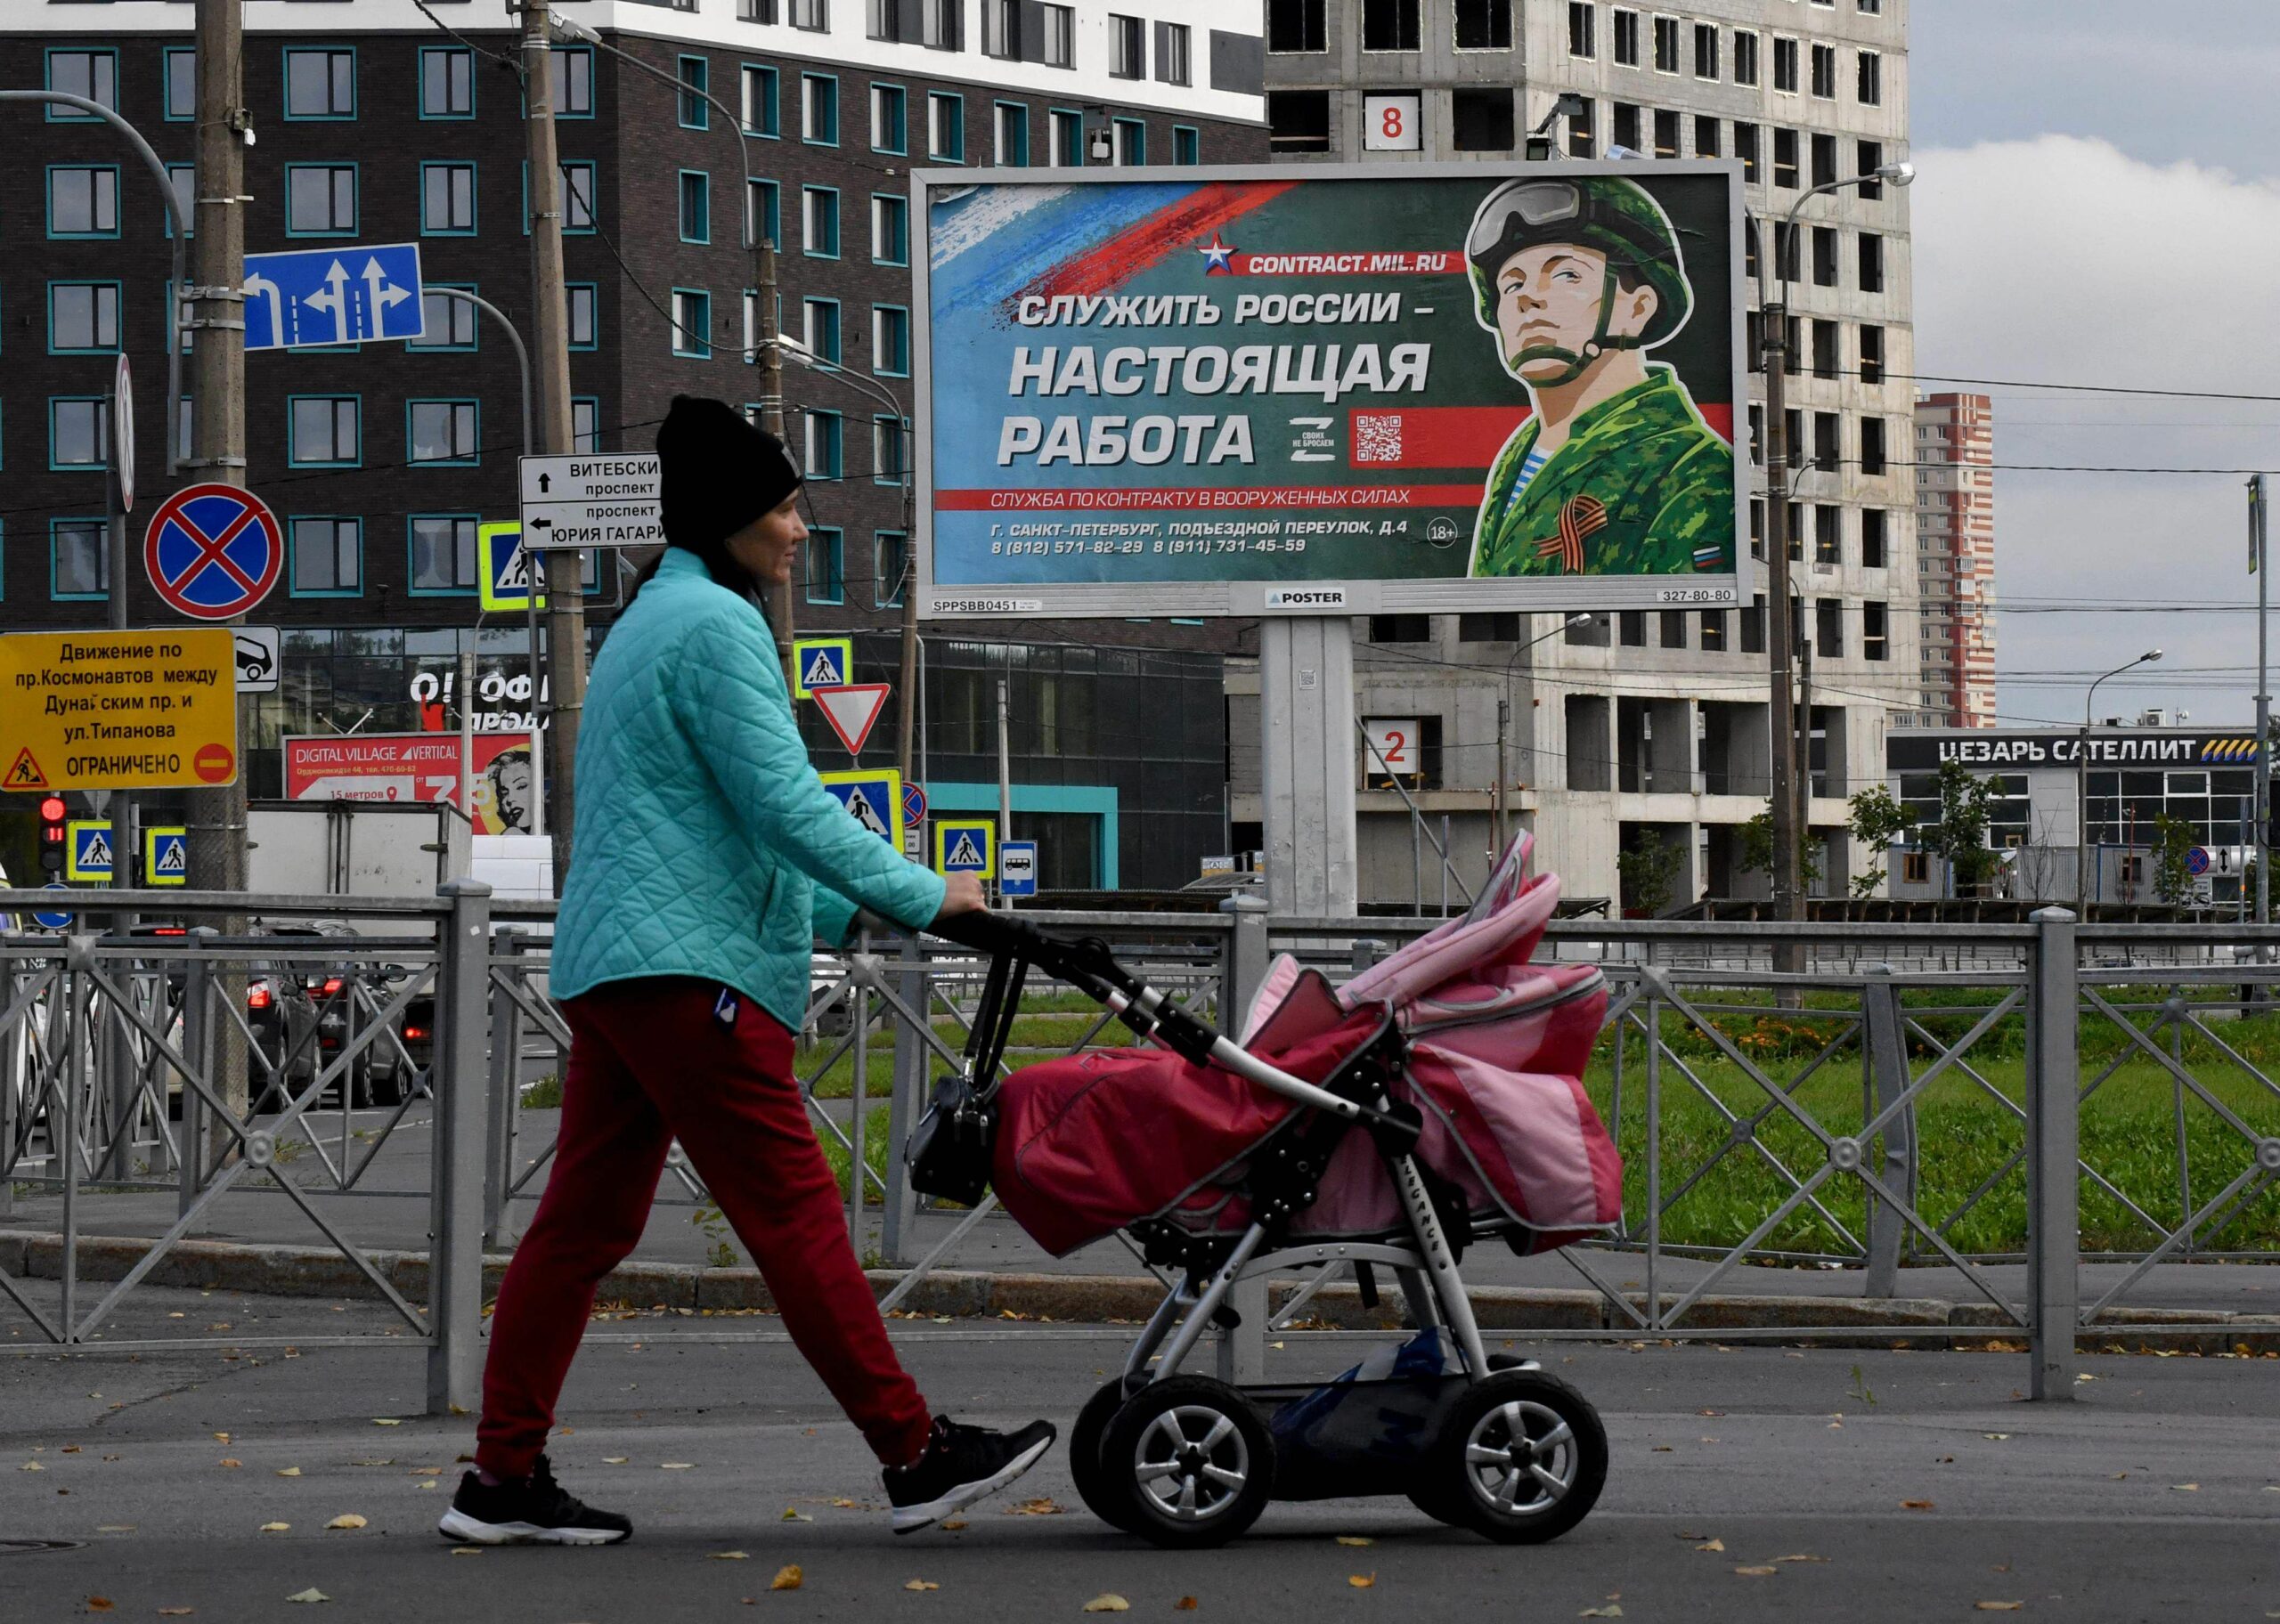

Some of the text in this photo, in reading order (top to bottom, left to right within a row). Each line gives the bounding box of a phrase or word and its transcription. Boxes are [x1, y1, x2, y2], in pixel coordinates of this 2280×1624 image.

[1382, 107, 1403, 138] 8
[1249, 253, 1447, 274] CONTRACT.MIL.RU
[1018, 294, 1222, 327] СЛУЖИТЬ
[1234, 292, 1402, 325] РОССИИ
[1007, 343, 1432, 403] НАСТОЯЩАЯ
[997, 414, 1257, 467] РАБОТА
[1292, 439, 1335, 447] НЕ БРОСАЕМ
[1302, 432, 1325, 440] СВОИХ
[570, 460, 661, 477] ВИТЕБСКИ
[585, 483, 655, 498] проспект
[990, 489, 1411, 508] СЛУЖБА ПО КОНТРАКТУ В ВООРУЖЕННЫХ СИЛАХ
[586, 506, 656, 520] проспект
[551, 527, 601, 543] ЮРИЯ
[990, 524, 1004, 537] Г.
[1009, 523, 1162, 538] САНКТ-ПЕТЕРБУРГ,
[1168, 519, 1280, 537] ПОДЪЕЗДНОЙ
[1284, 521, 1374, 535] ПЕРЕУЛОК,
[1430, 526, 1455, 540] 18+
[991, 540, 1307, 556] 8 (812) 571-82-29 8 (911) 731-45-59
[1282, 592, 1343, 604] POSTER
[1663, 590, 1731, 601] 327-80-80
[933, 601, 1017, 612] SPPSBB0451
[60, 643, 183, 663] Движение по
[15, 669, 217, 690] пр.Космонавтов между
[150, 695, 176, 712] пр.
[182, 694, 192, 708] и
[63, 722, 175, 744] ул.Типанова
[296, 745, 458, 763] DIGITAL VILLAGE VERTICAL
[1384, 731, 1405, 762] 2
[1939, 740, 2196, 764] ЦЕЗАРЬ САТЕЛЛИТ
[66, 753, 181, 777] ОГРАНИЧЕНО
[345, 791, 384, 800] метров
